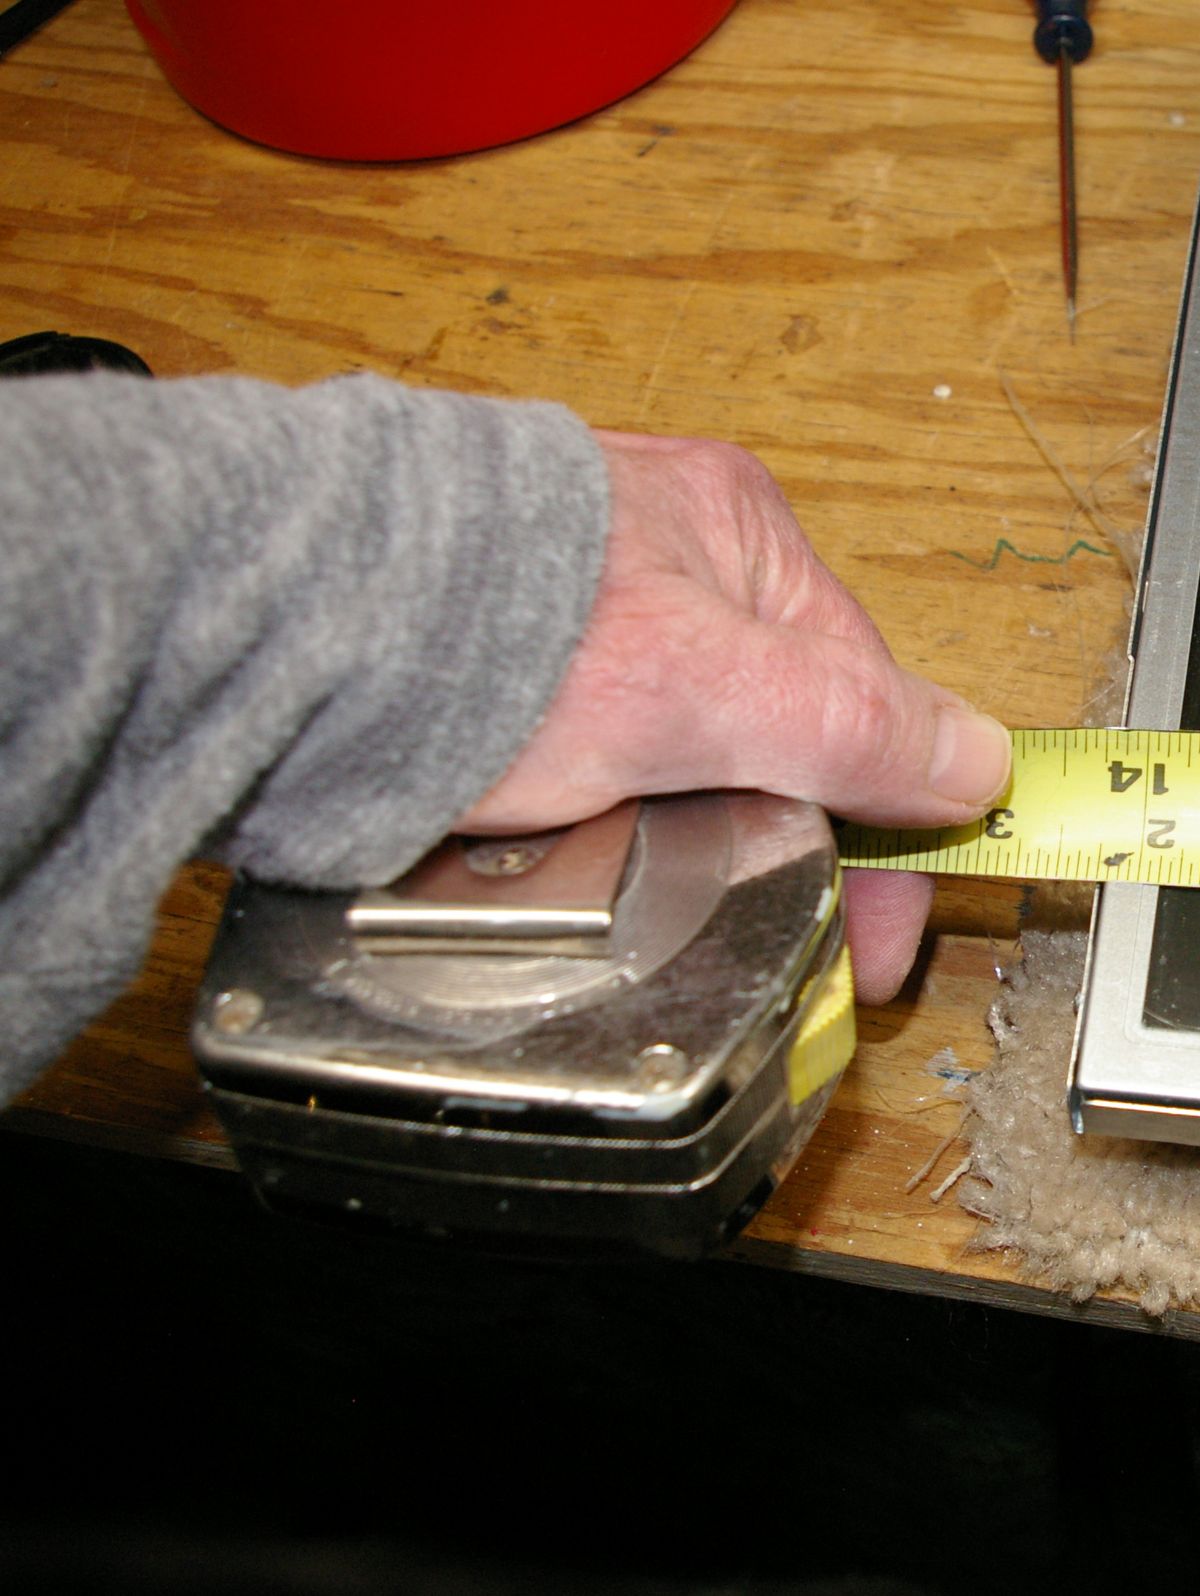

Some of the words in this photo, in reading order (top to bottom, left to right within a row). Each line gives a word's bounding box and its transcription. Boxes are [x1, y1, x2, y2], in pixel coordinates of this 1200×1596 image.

[1108, 761, 1168, 795] 14
[985, 808, 1014, 839] 3
[1147, 819, 1176, 848] 2
